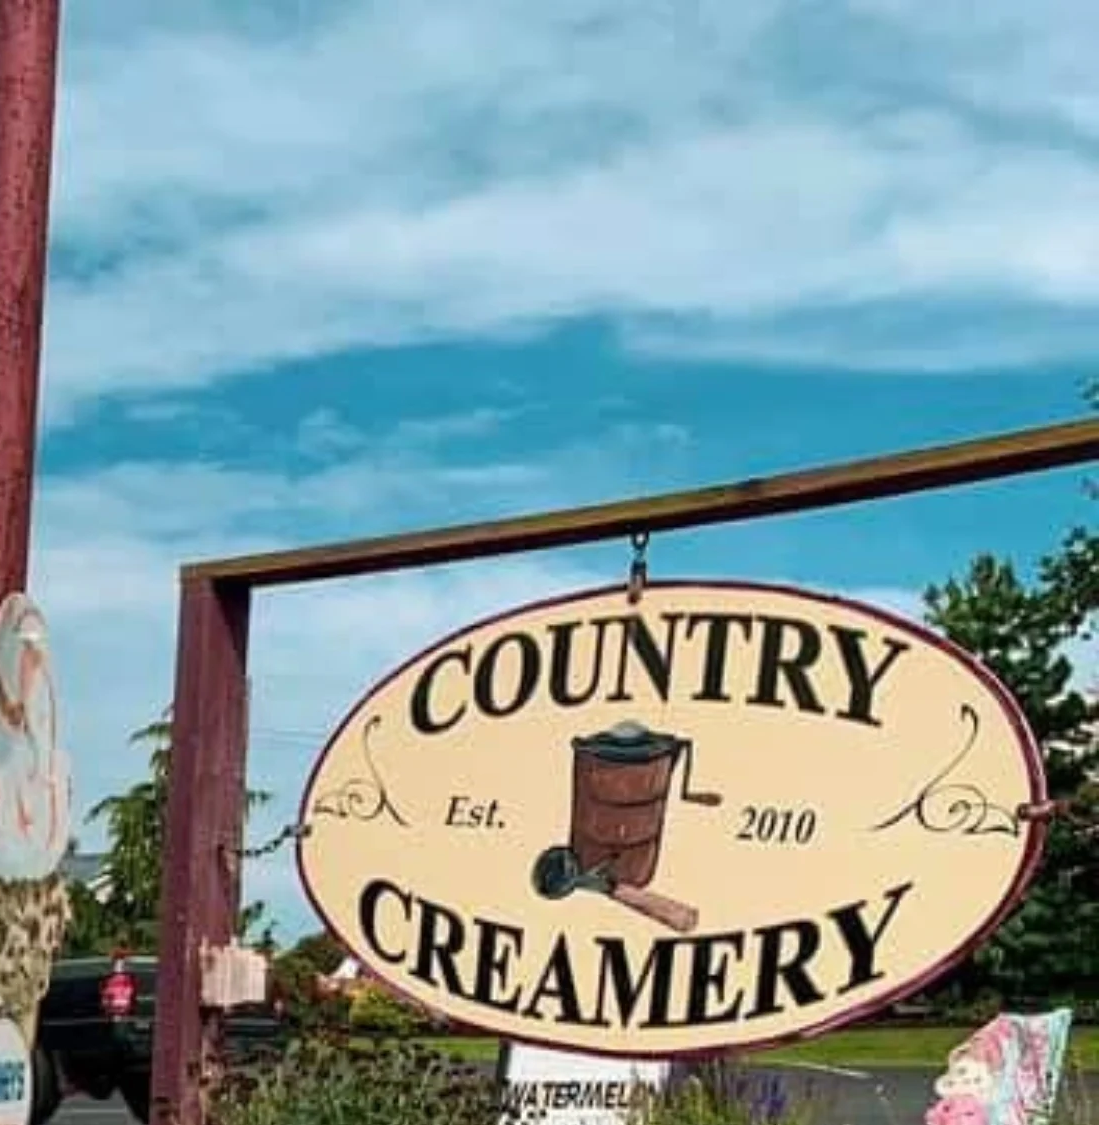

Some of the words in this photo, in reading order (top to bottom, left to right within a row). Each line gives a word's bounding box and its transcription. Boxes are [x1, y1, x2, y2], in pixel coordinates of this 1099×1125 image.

[410, 611, 911, 735] COUNTRY
[445, 796, 506, 829] Est.
[737, 806, 817, 844] 2010
[358, 879, 914, 1030] CREAMERY
